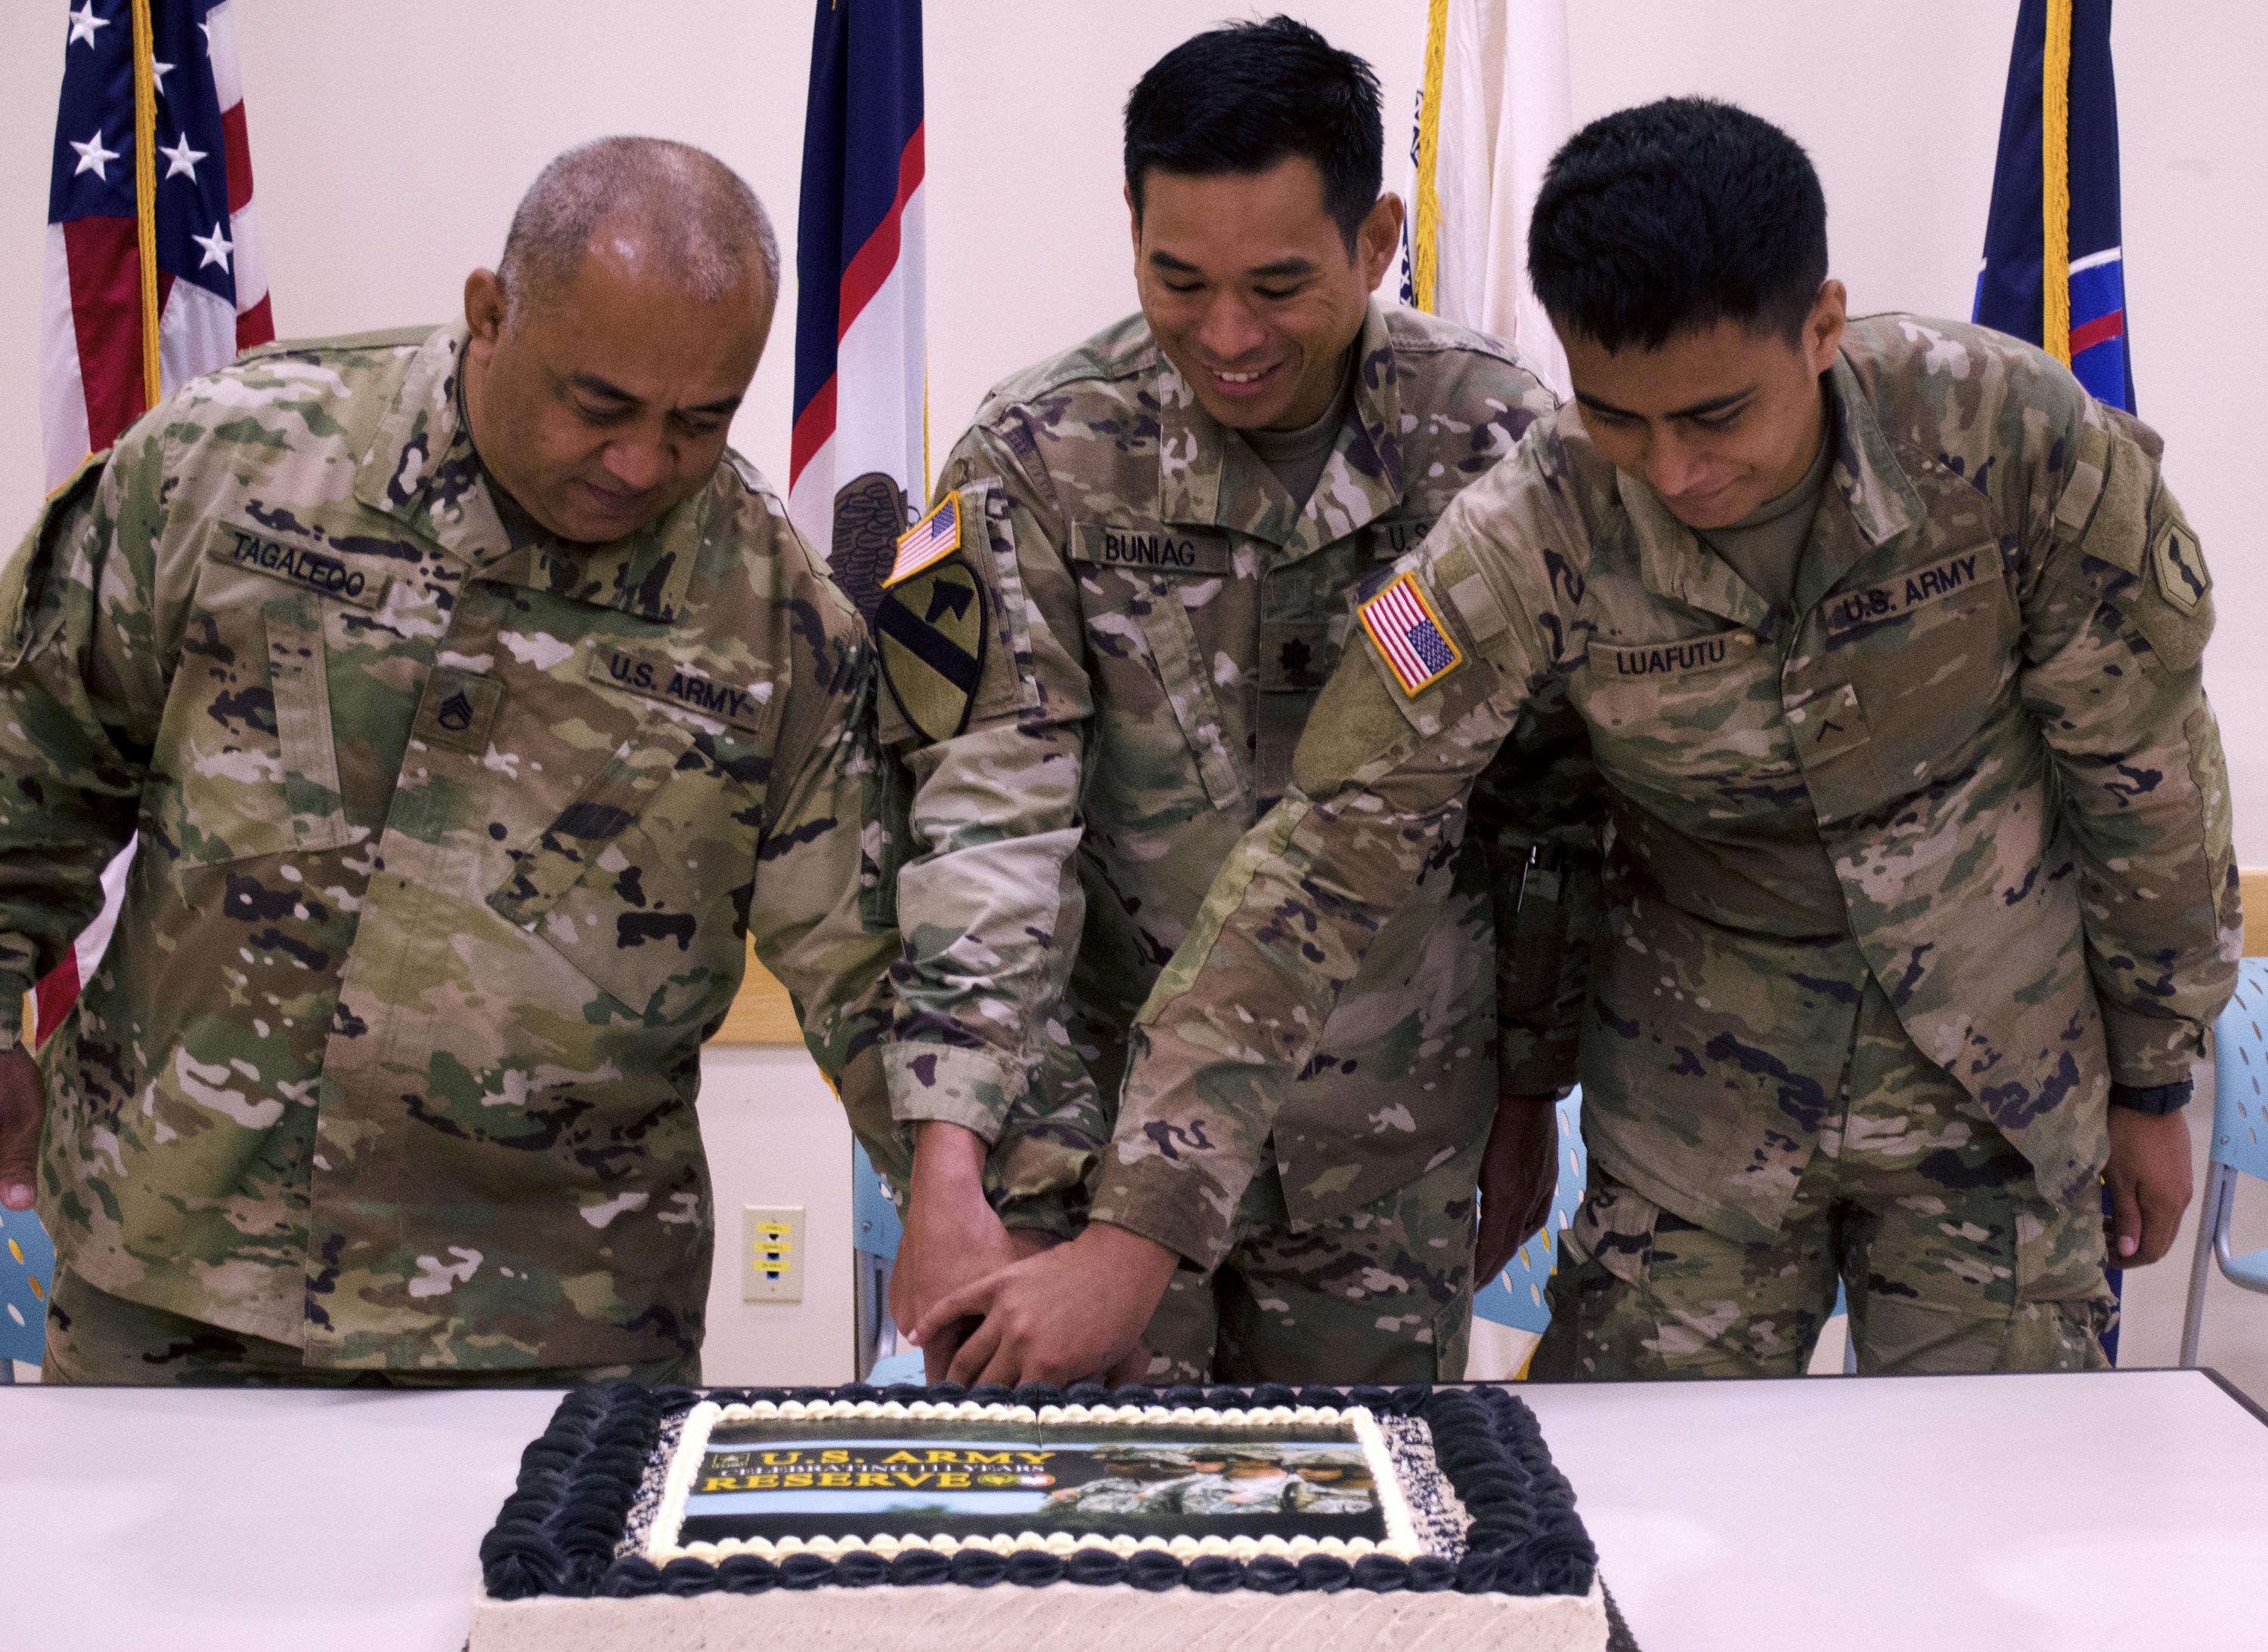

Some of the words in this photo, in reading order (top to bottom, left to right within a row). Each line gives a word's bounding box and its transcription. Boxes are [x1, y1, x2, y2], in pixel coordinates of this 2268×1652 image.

[233, 531, 365, 597] TAGALEOO
[1105, 534, 1195, 566] BUNIAG
[1842, 587, 1897, 621] U.S.
[1905, 553, 1976, 606] ARMY
[1616, 639, 1726, 675] LUAFUTU
[609, 652, 657, 691] U.S.
[666, 671, 746, 718] ARMY
[721, 1464, 908, 1476] CELEBRATING
[962, 1464, 1046, 1473] YEARS
[761, 1449, 865, 1466] U.S.
[881, 1450, 1056, 1464] ARMY
[702, 1472, 972, 1492] RESERVE
